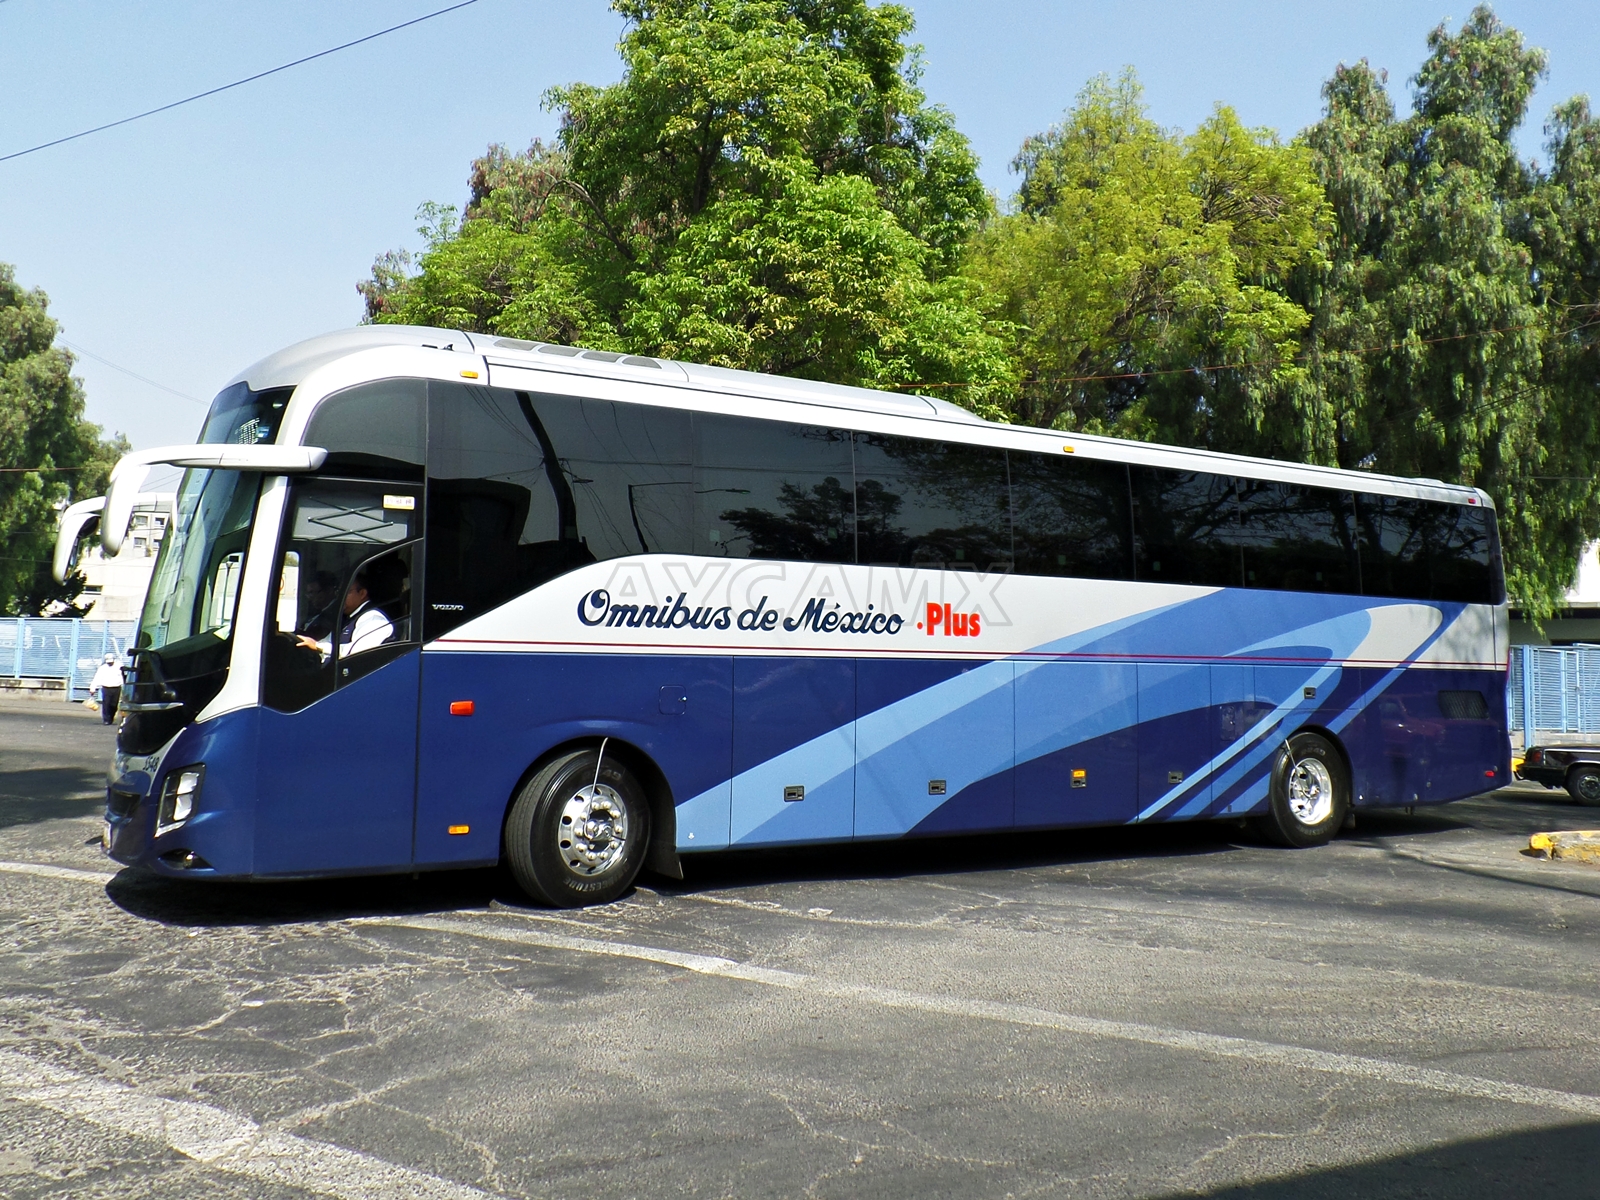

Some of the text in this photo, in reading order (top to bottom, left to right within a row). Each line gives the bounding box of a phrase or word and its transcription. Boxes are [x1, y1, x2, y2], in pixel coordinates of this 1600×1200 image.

[431, 603, 464, 611] VOLVO
[577, 588, 732, 630] Omnibus
[737, 596, 779, 631] de
[782, 598, 905, 634] México
